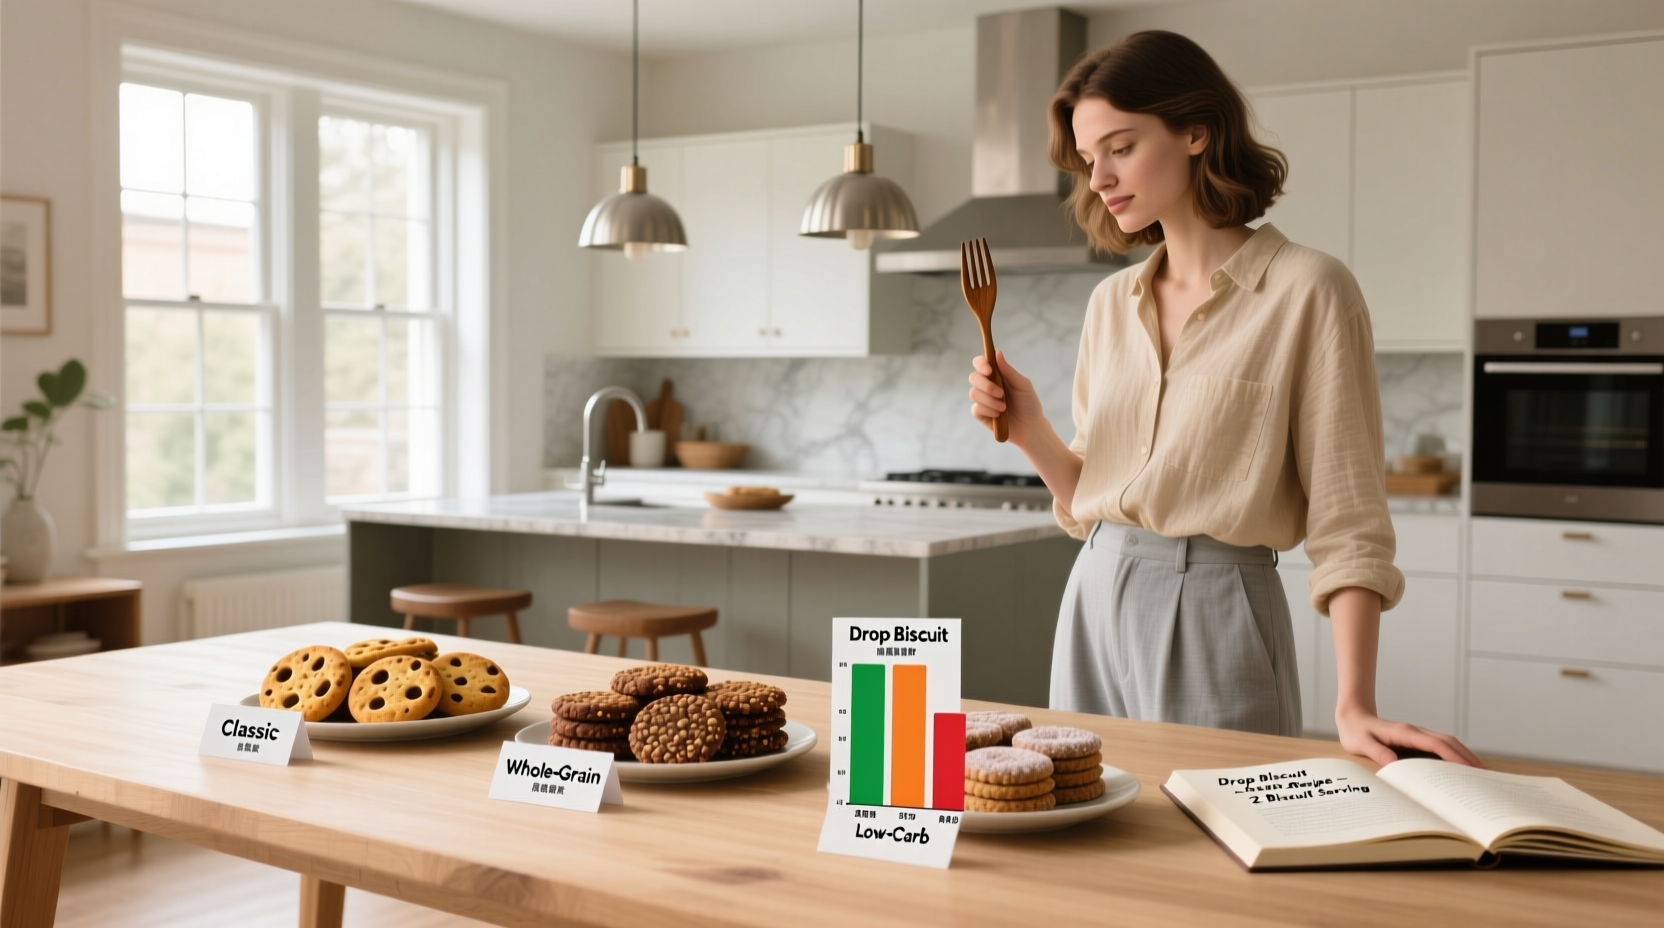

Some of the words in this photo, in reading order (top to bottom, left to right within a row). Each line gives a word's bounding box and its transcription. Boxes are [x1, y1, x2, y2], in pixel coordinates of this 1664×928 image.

[849, 625, 891, 646] Drop
[893, 625, 949, 643] Biscuit
[221, 718, 280, 741] Classic
[506, 758, 601, 785] Whole-Grain
[1218, 777, 1255, 790] Drop
[1248, 795, 1264, 804] 2
[855, 822, 930, 845] Low-Carb
